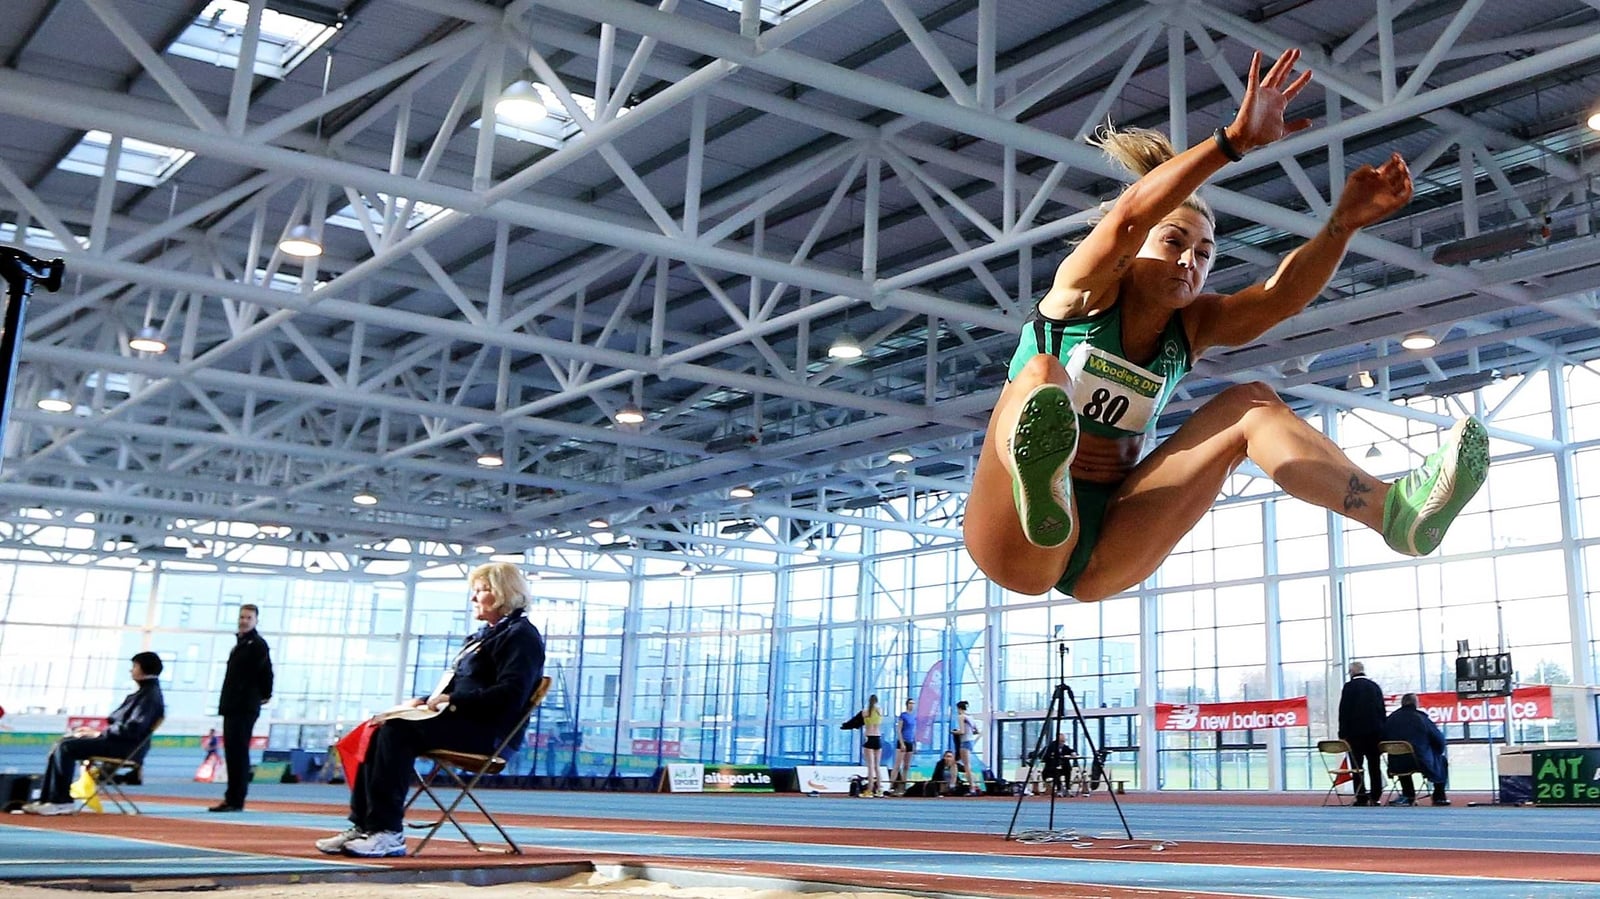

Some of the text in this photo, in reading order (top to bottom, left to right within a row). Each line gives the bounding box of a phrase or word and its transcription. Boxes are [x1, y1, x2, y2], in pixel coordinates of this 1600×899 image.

[1089, 356, 1141, 386] Woodie's
[1141, 380, 1160, 393] DIY
[1083, 388, 1130, 426] 80
[1481, 679, 1506, 692] JUMP
[1200, 711, 1297, 730] new balance
[1537, 756, 1584, 780] AIT
[704, 772, 771, 786] aitsport.ie
[1537, 783, 1566, 799] 26
